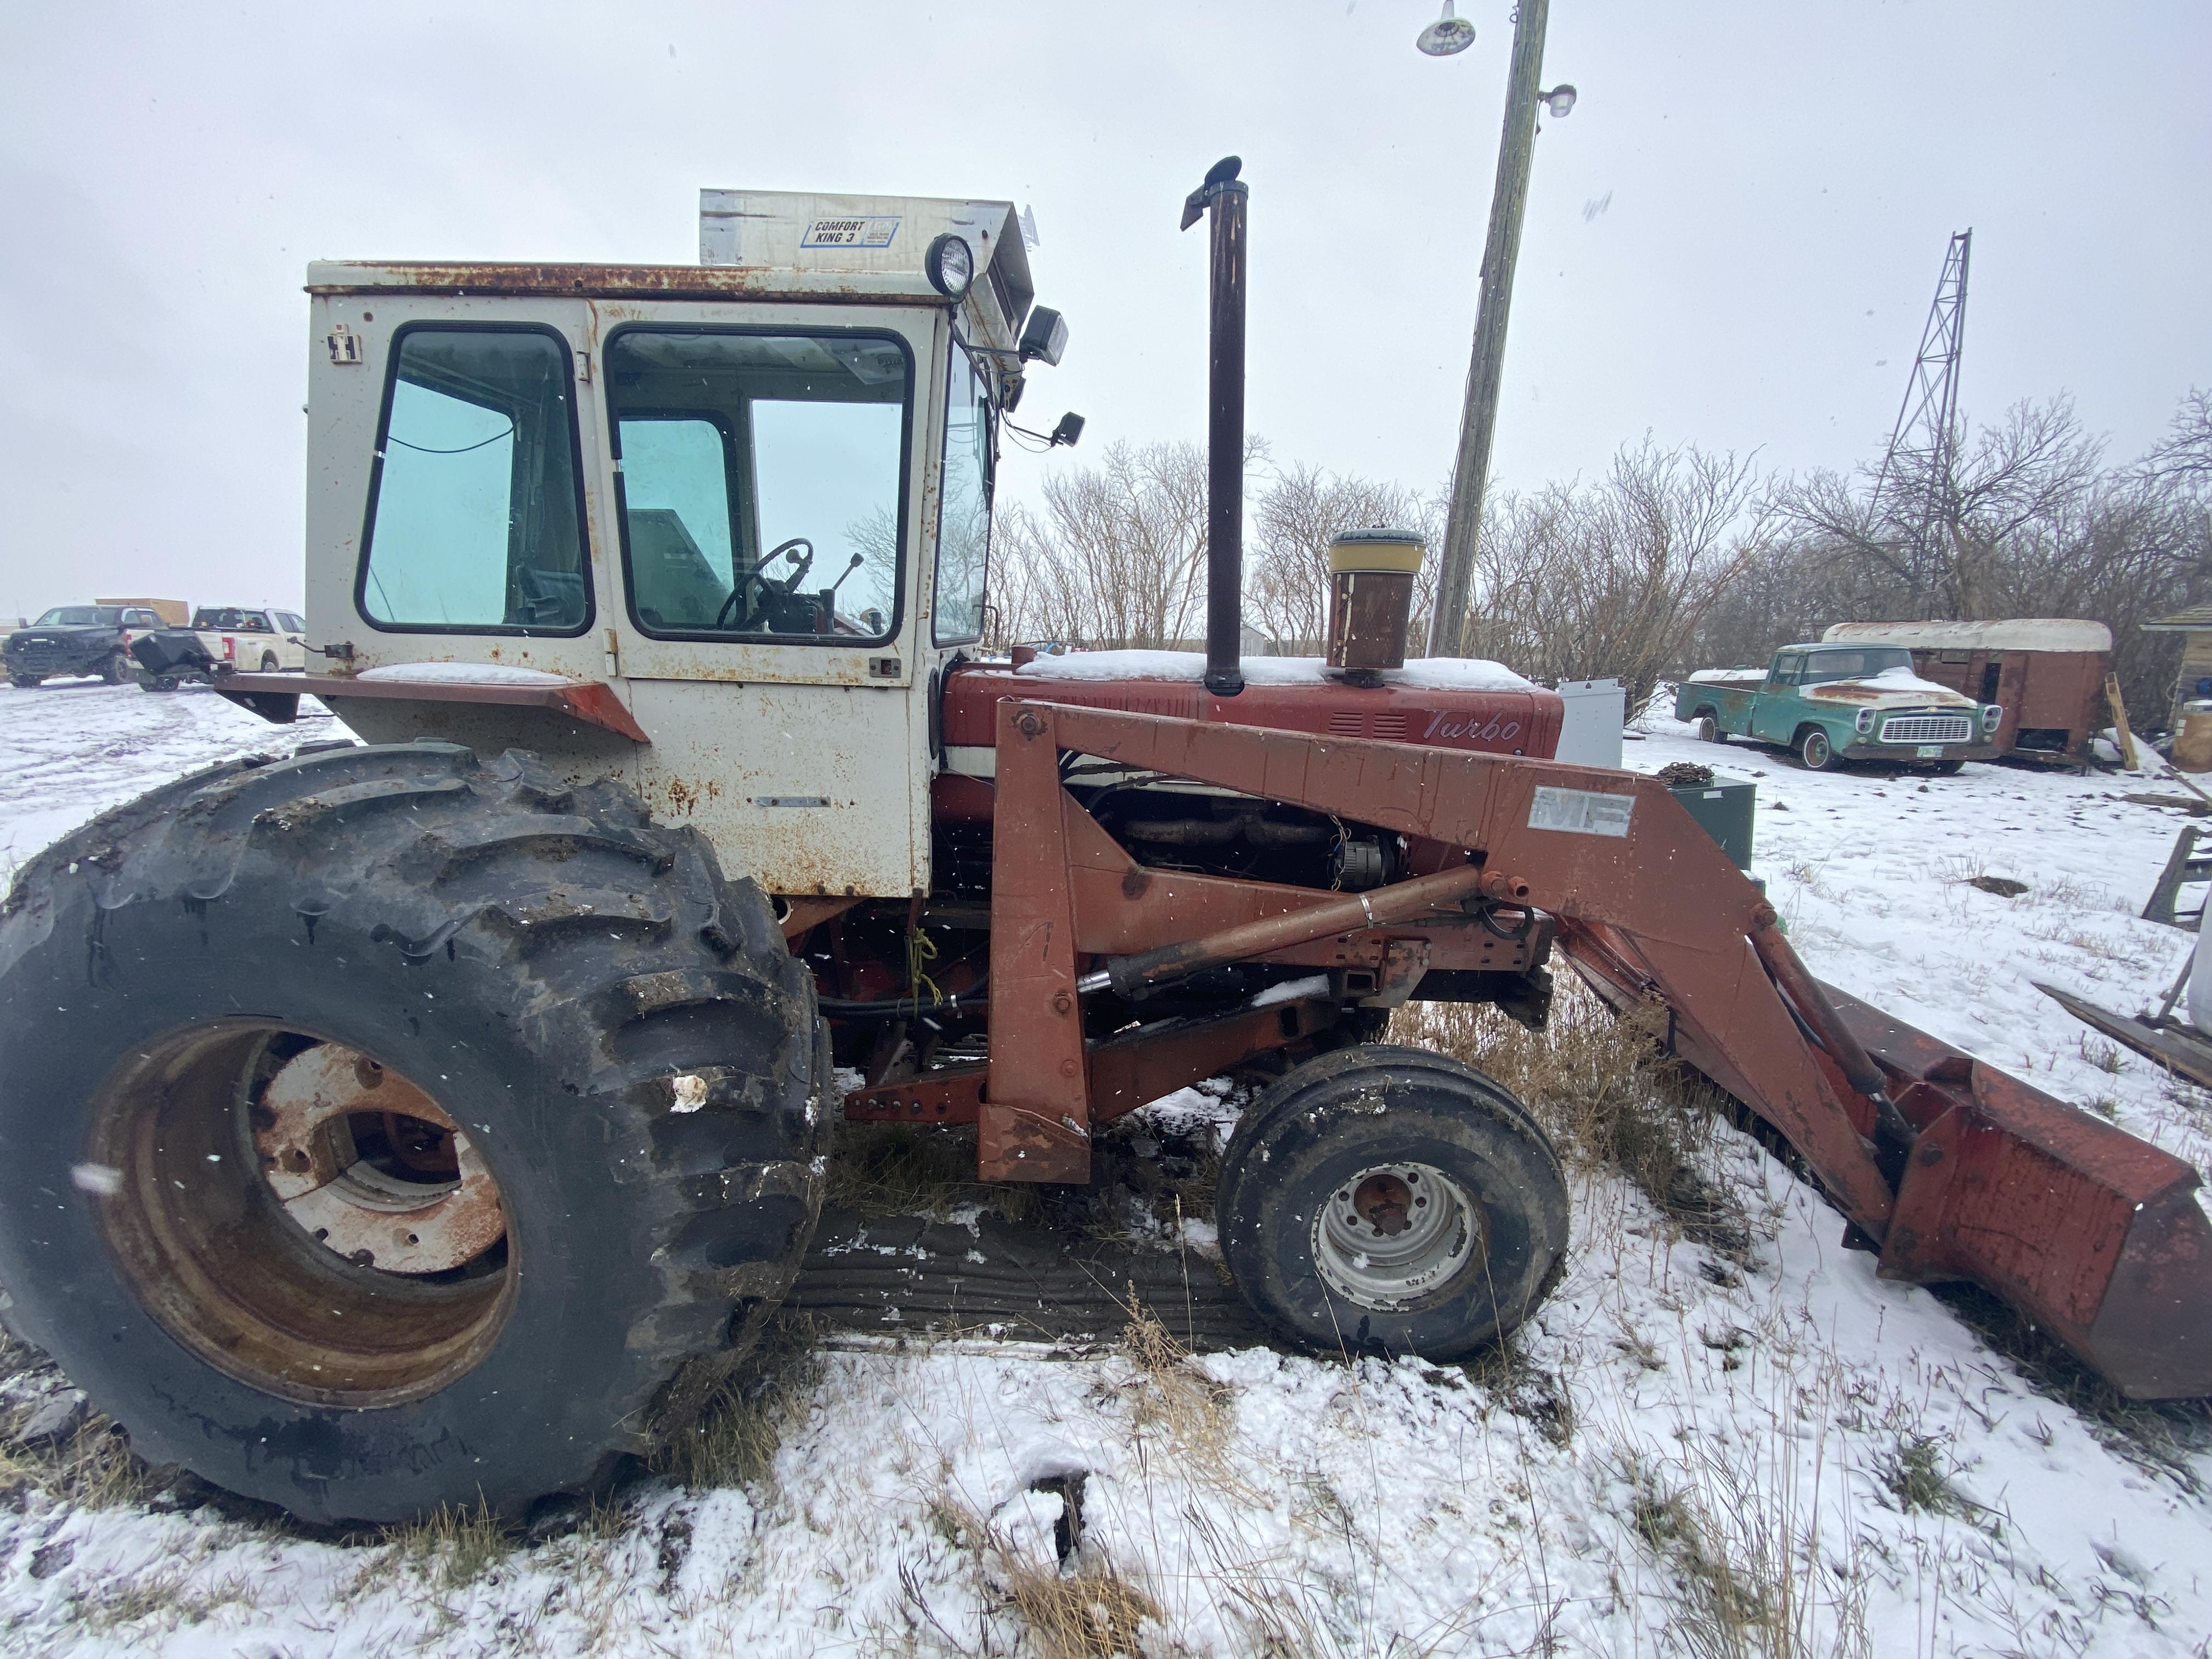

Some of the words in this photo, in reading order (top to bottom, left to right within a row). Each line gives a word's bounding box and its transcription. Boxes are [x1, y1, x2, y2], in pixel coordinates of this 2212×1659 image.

[815, 221, 865, 231] COMFORT
[815, 233, 842, 242] KING
[846, 233, 854, 242] 3
[1423, 708, 1520, 741] Turbo
